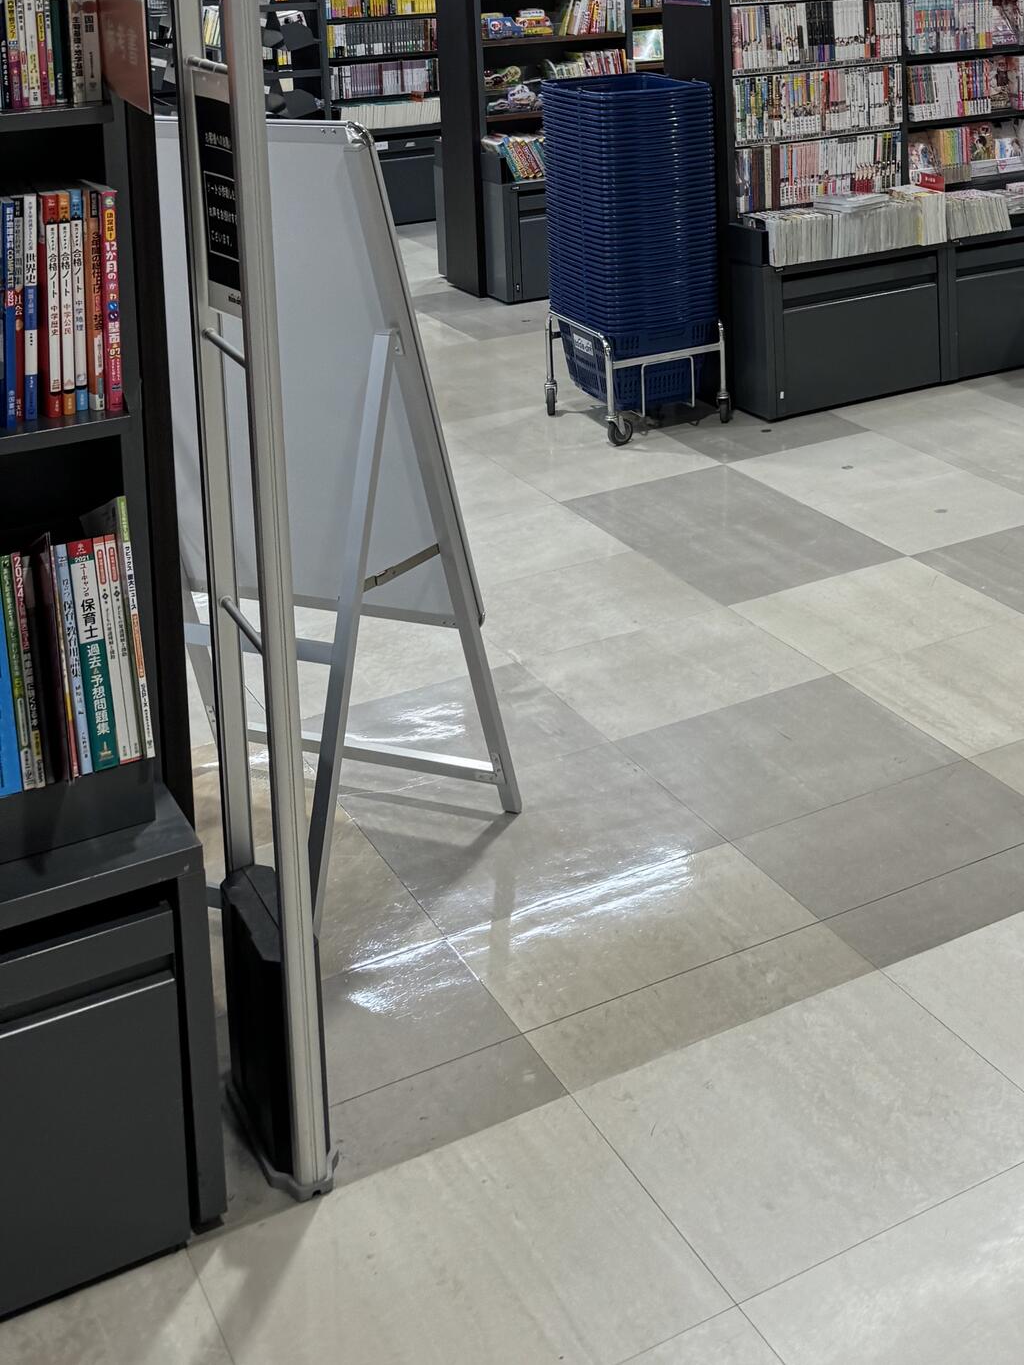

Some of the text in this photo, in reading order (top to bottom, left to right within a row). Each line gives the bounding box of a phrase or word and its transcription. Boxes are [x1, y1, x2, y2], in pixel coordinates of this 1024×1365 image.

[26, 253, 36, 285] 世界史
[48, 253, 58, 298] 合格ノート
[61, 252, 71, 296] 合格ノート
[73, 249, 83, 293] 合格ノート
[74, 555, 90, 563] 2021
[79, 563, 90, 597] ユーキャンの
[81, 598, 98, 640] 保育士
